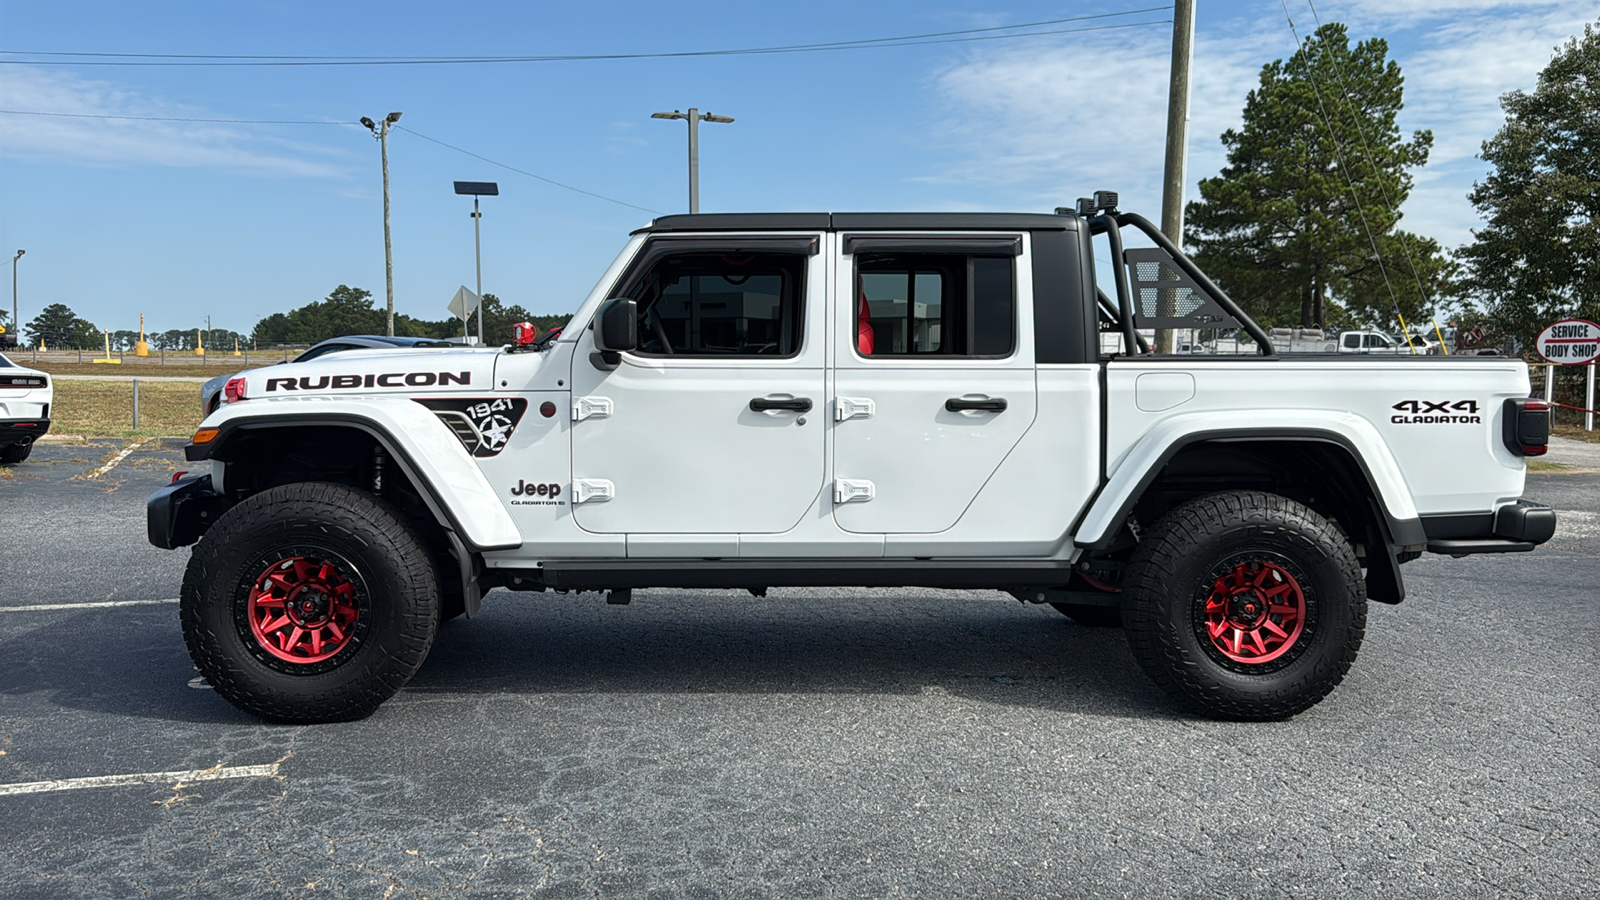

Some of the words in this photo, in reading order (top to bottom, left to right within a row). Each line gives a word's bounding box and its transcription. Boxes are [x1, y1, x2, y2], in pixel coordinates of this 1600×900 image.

[1551, 325, 1589, 338] SERVICE
[1545, 344, 1569, 357] BODY
[1572, 344, 1597, 357] SHOP
[266, 371, 471, 392] RUBICON
[466, 398, 514, 418] 1941
[1391, 415, 1481, 424] GLADIATOR
[511, 479, 561, 499] Jeep
